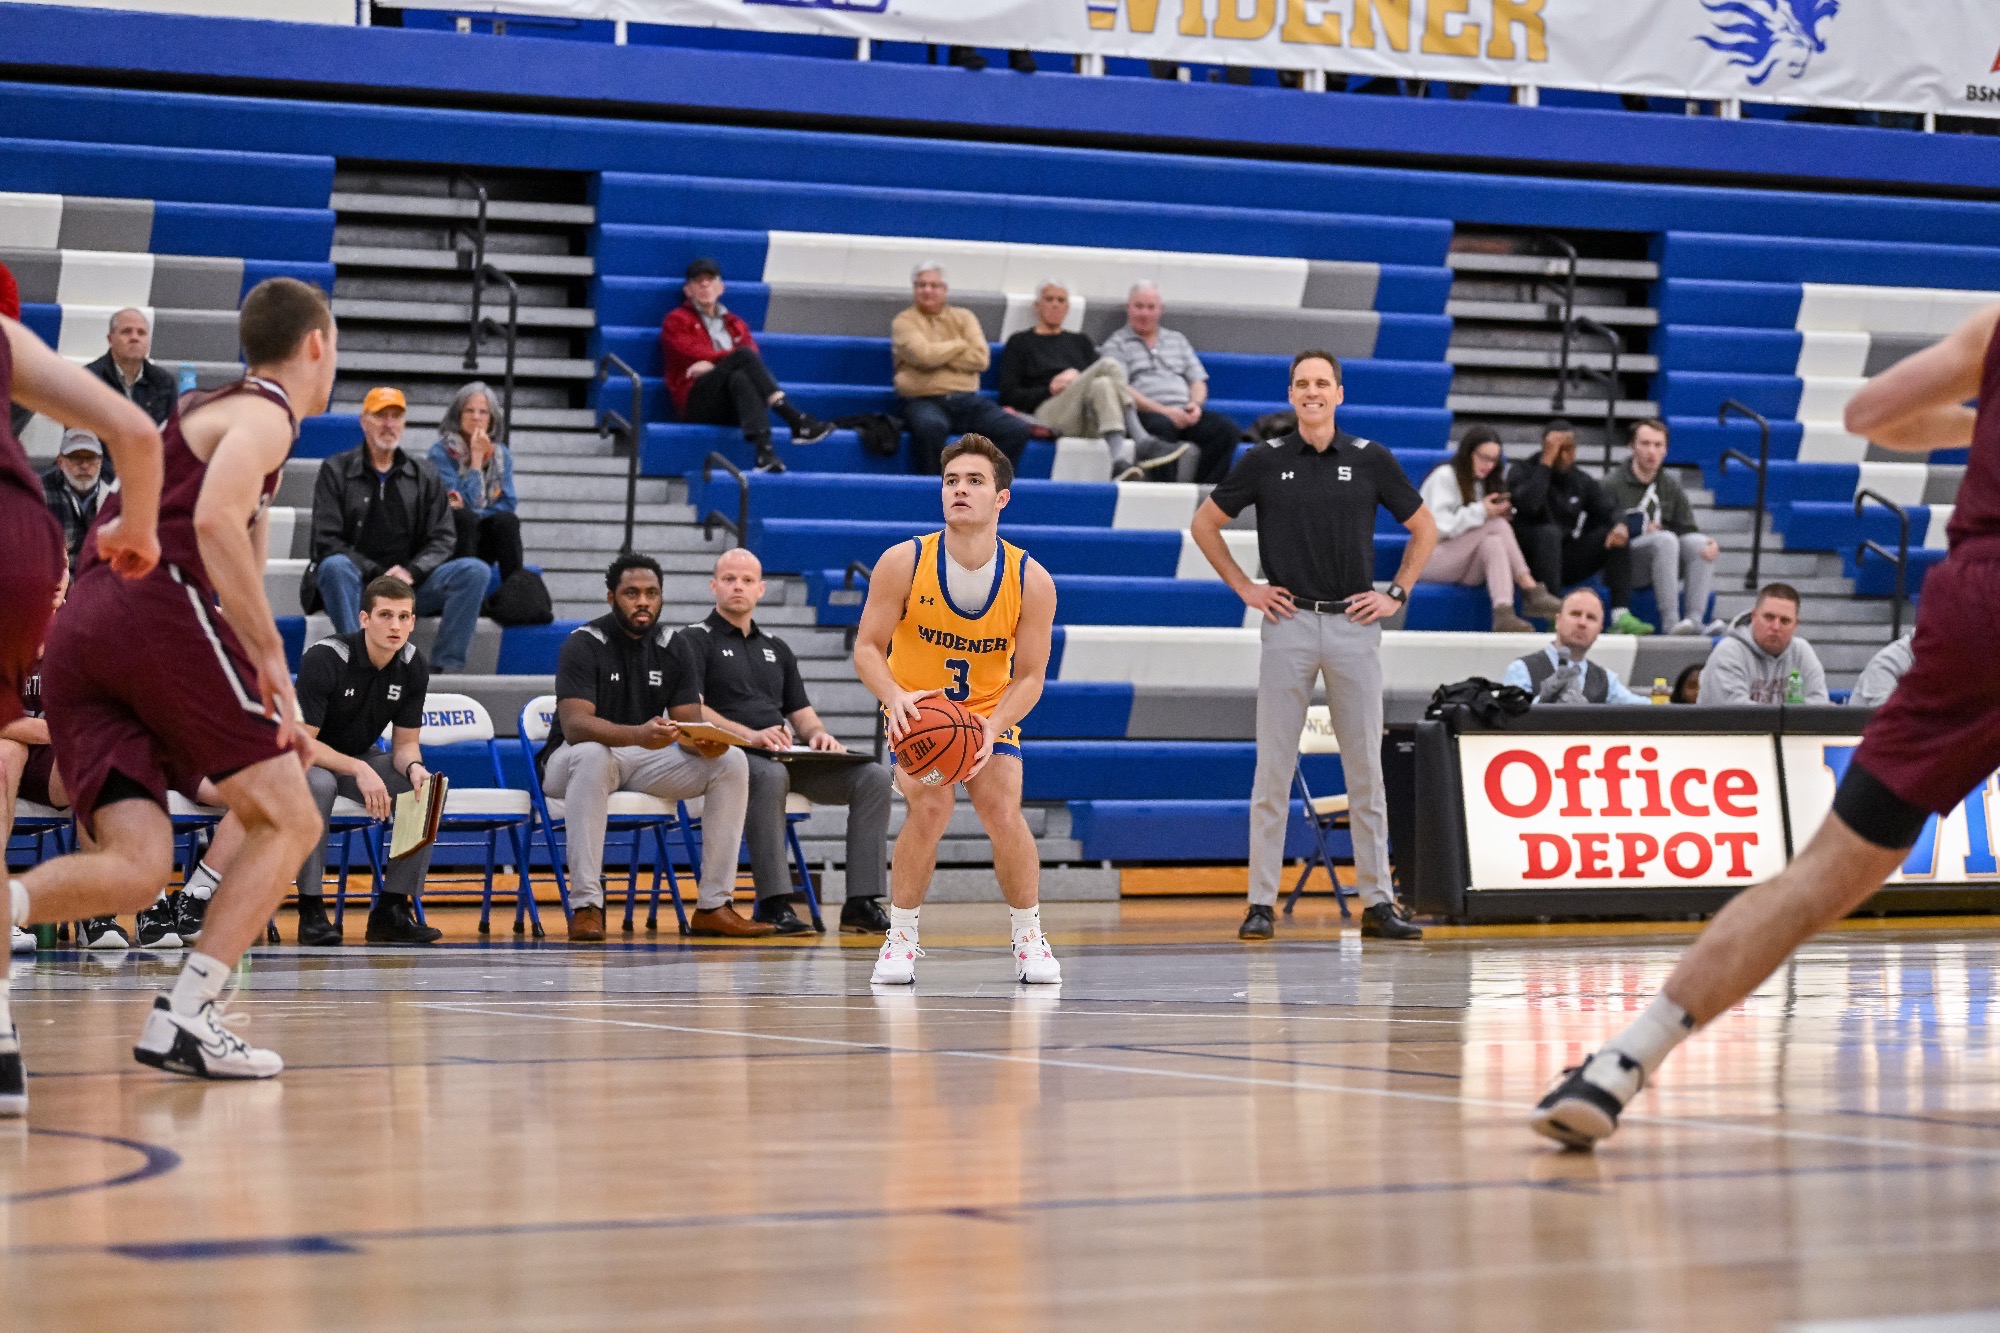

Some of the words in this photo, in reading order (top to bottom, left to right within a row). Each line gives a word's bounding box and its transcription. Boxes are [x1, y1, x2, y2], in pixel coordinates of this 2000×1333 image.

[1338, 466, 1352, 481] S
[918, 625, 1007, 653] WIDENER
[762, 648, 776, 663] S
[649, 670, 663, 687] S
[944, 658, 970, 702] 3
[387, 684, 402, 701] S
[910, 736, 936, 761] THE
[1484, 745, 1758, 819] Office
[1519, 832, 1758, 880] DEPOT
